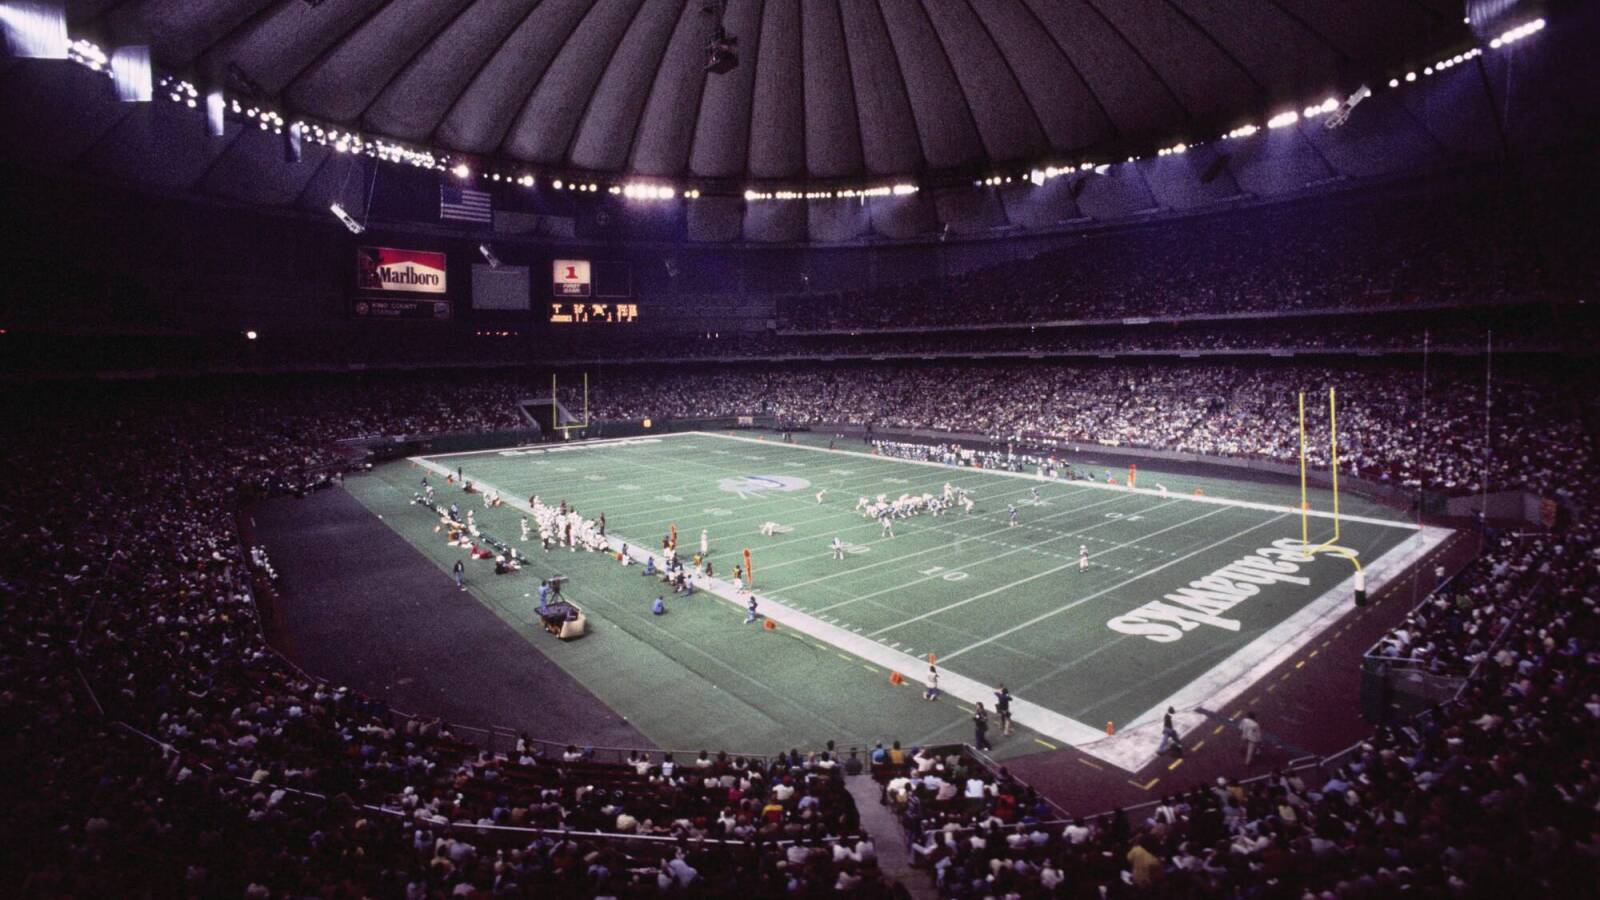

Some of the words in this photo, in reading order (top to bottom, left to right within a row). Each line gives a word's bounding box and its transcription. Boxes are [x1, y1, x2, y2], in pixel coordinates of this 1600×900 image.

[380, 266, 439, 285] Marlboro
[566, 266, 578, 279] 1
[918, 566, 969, 581] 10
